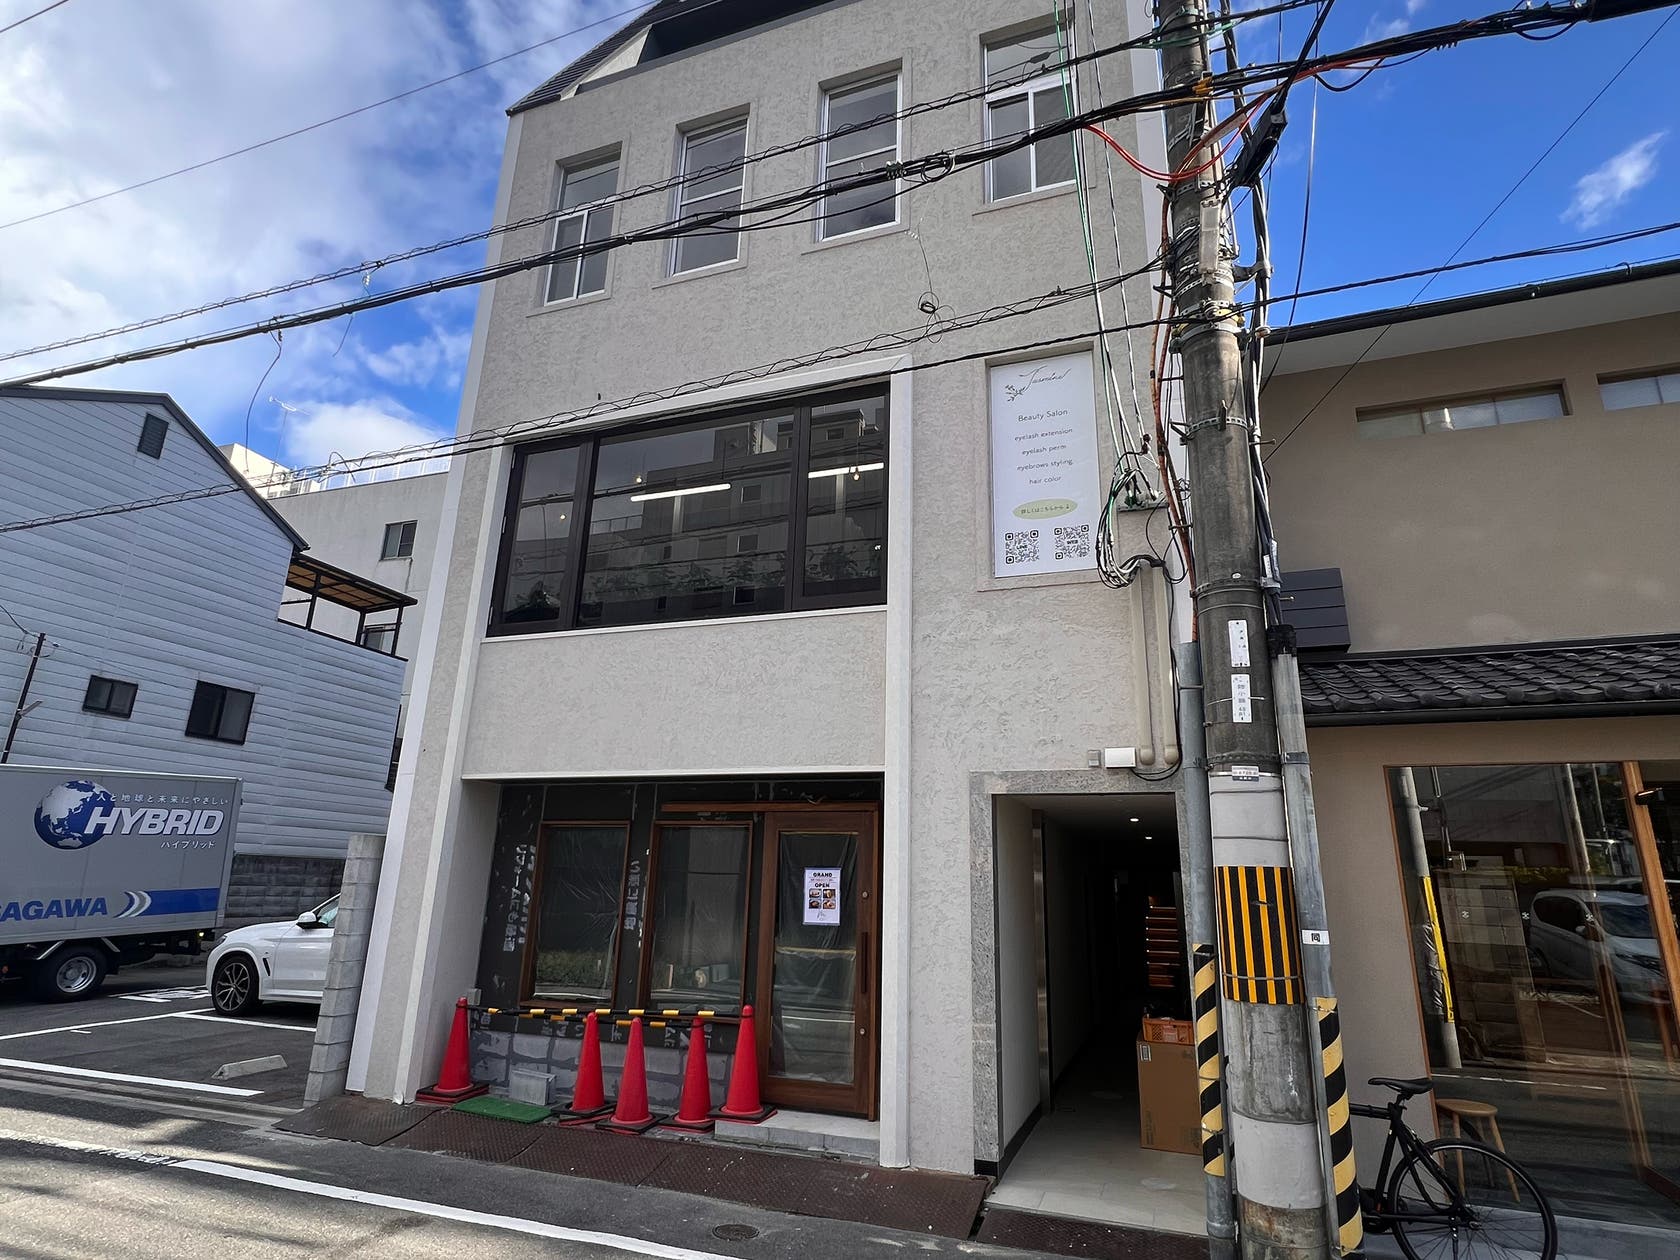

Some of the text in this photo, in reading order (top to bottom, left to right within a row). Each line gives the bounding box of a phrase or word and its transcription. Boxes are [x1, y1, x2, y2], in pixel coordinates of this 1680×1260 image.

[1018, 409, 1068, 422] Beauty Salon
[1014, 428, 1073, 442] eyelash extension
[1022, 444, 1067, 456] eyelash perm
[96, 792, 229, 805] 人と地球と未来にやさしい
[84, 806, 224, 835] HYBRID
[160, 840, 217, 849] ハイブリッド
[0, 897, 108, 922] AGAWA
